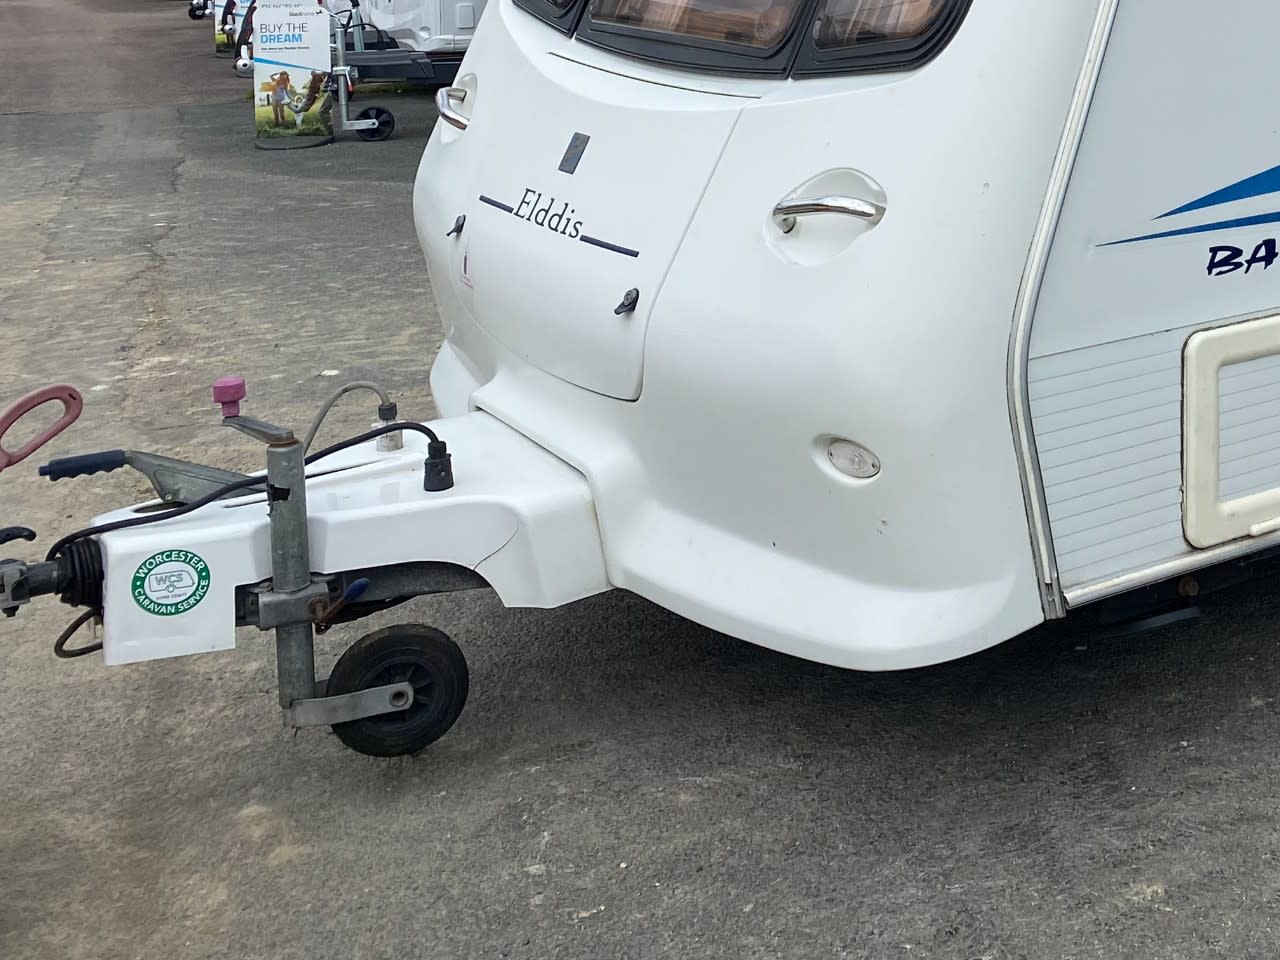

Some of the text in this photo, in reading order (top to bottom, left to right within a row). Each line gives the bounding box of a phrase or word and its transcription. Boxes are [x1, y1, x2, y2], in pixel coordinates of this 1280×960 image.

[260, 22, 309, 34] BUY THE
[260, 33, 303, 44] DREAM
[514, 188, 583, 239] Elddis
[135, 551, 205, 579] WORCESTER
[154, 573, 184, 586] WCS
[134, 579, 209, 614] CARAVAN SERVICE
